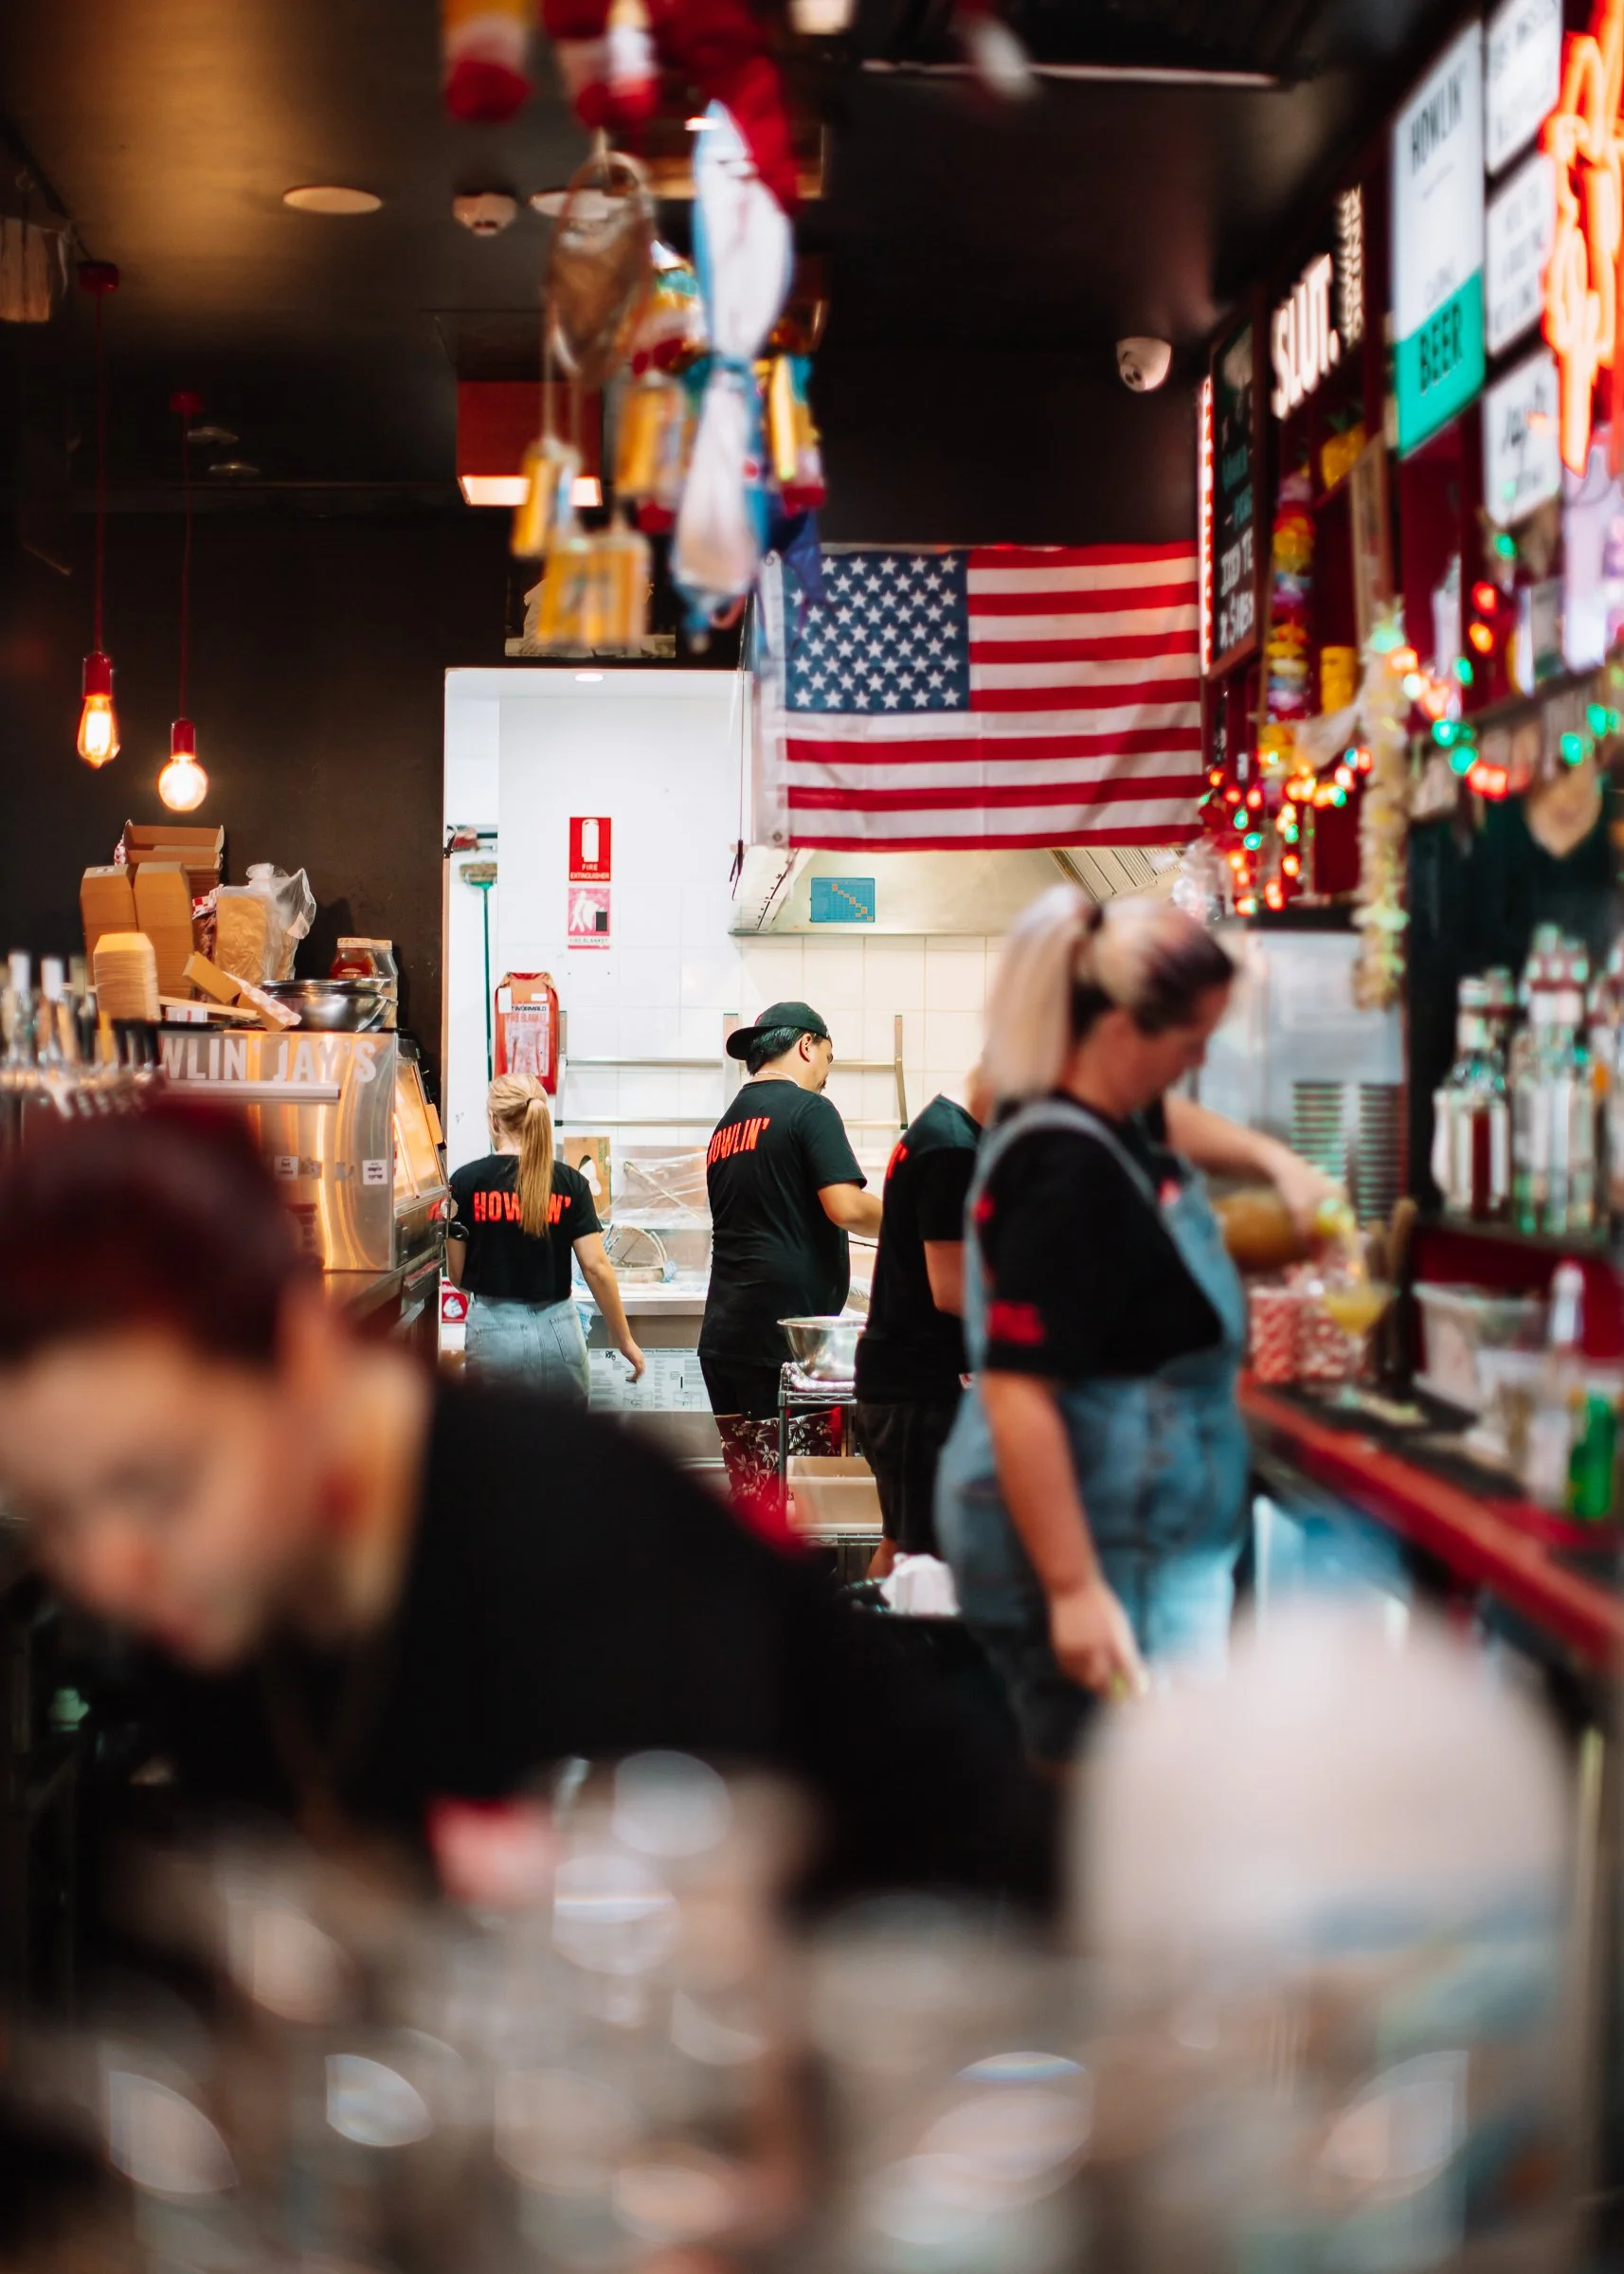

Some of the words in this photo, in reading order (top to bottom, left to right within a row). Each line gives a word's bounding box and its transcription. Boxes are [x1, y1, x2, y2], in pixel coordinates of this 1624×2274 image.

[1420, 301, 1463, 392] BEER
[162, 1038, 261, 1079] WLIN'
[273, 1040, 376, 1082] JAY'S
[474, 1190, 571, 1225] HOWN'
